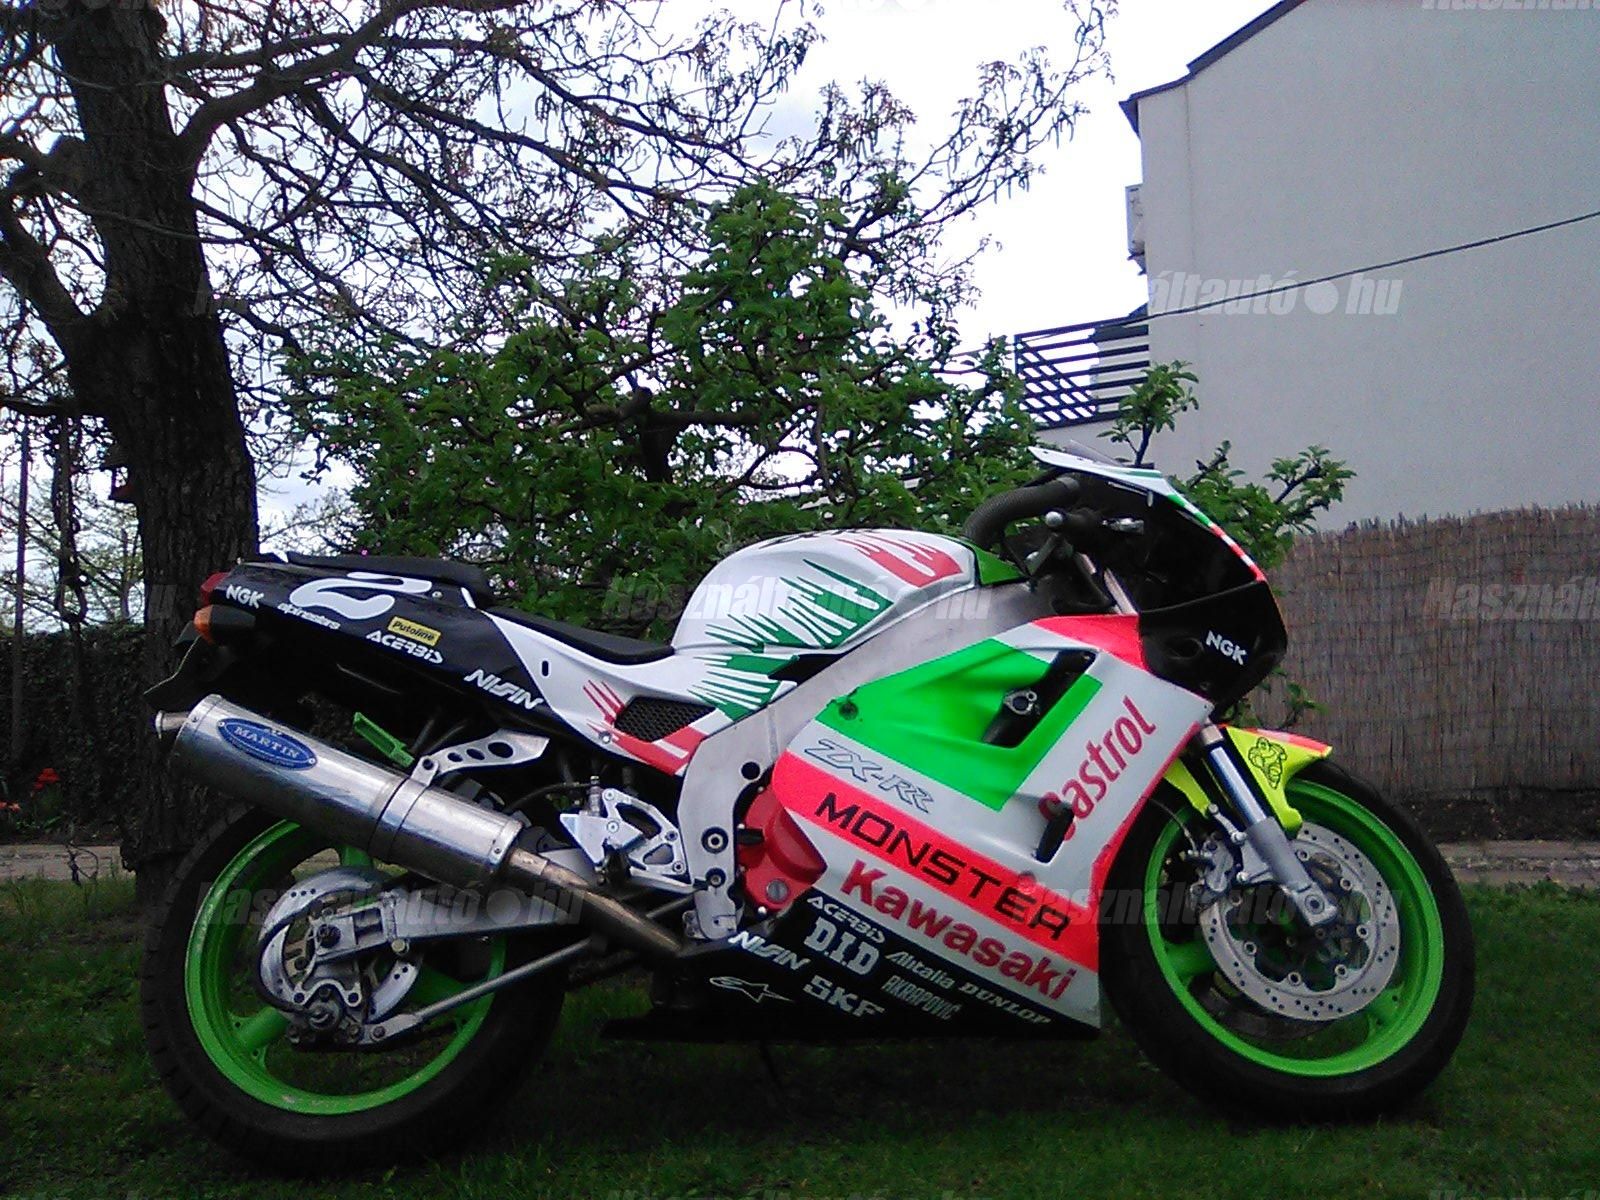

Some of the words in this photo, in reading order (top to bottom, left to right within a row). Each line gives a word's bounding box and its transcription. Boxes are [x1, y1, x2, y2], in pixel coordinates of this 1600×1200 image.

[226, 584, 265, 609] NGK
[366, 630, 444, 664] ACERBIS
[392, 620, 435, 641] Putoline
[1205, 629, 1248, 666] NGK
[234, 725, 301, 759] MARTIN
[815, 792, 1071, 942] MONSTER
[807, 896, 886, 944] ACERBIS
[840, 859, 1077, 1000] Kawasaki
[803, 974, 885, 1017] SKF
[884, 951, 955, 989] Alitalia
[958, 982, 1051, 1024] DUNLOP
